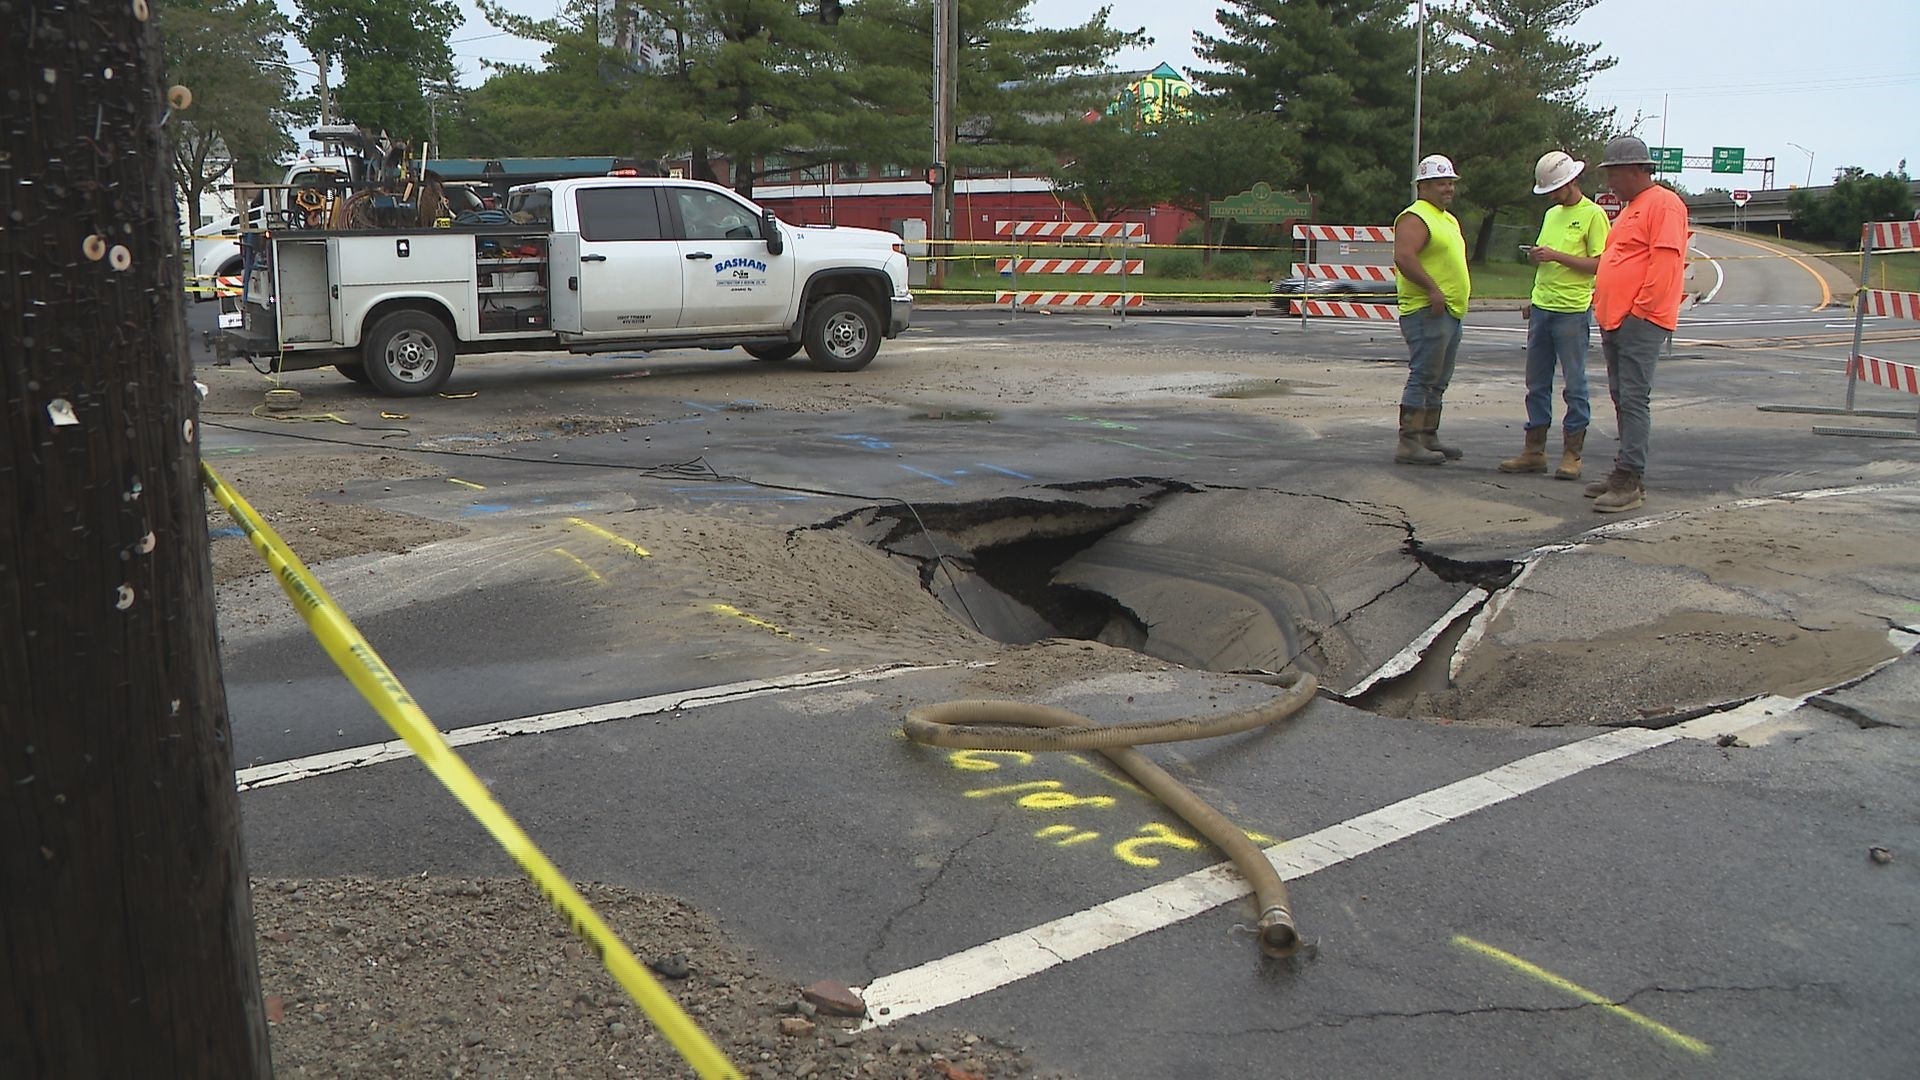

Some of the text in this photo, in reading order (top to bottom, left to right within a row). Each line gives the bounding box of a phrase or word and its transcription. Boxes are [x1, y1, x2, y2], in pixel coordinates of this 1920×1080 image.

[1214, 207, 1308, 216] HISTORIC PORTLAND
[714, 258, 767, 273] BASHAM
